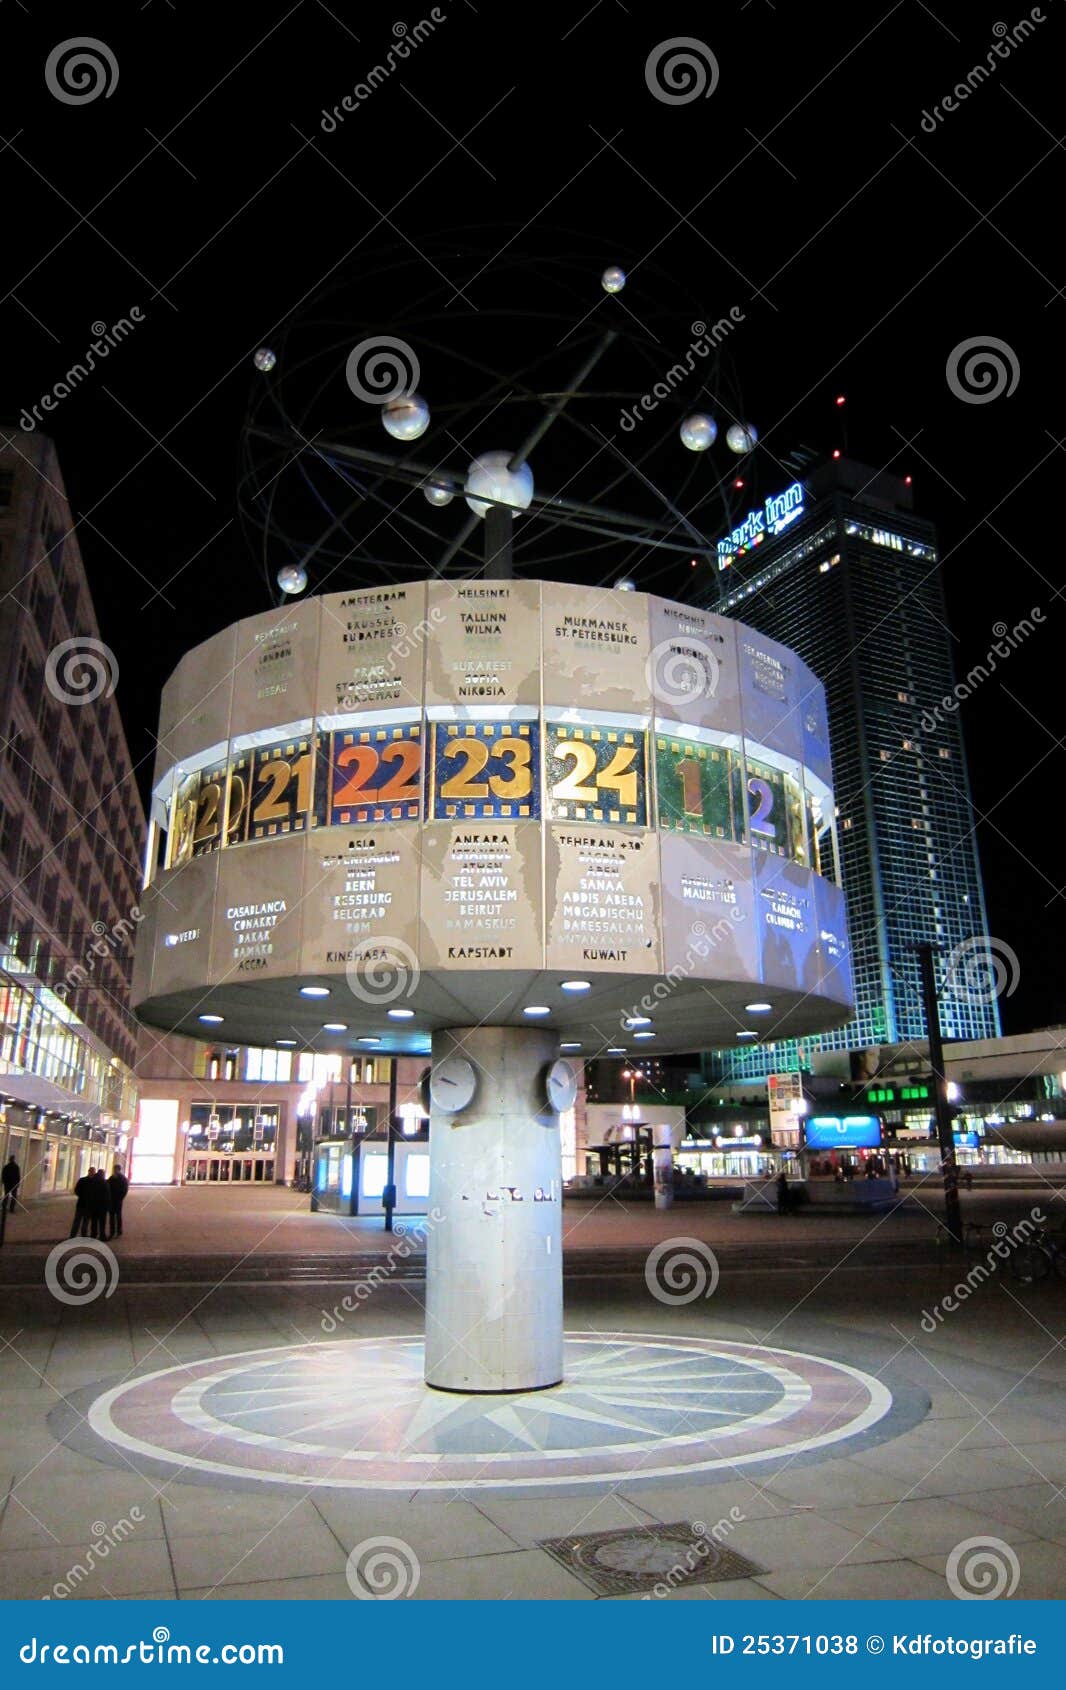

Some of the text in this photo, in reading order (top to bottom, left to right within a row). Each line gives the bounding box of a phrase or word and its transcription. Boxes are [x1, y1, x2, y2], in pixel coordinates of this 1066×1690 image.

[765, 483, 803, 526] inn
[341, 591, 406, 607] AMSTERDAM
[458, 589, 510, 598] HELSINKI
[460, 613, 507, 622] TALLINN
[465, 625, 502, 635] WILNA
[564, 616, 629, 634] MURMANSK
[464, 674, 500, 684] SOFIA
[458, 687, 506, 696] NIKOSIA
[334, 741, 421, 807] 22
[441, 738, 533, 799] 23
[552, 741, 638, 805] 24
[253, 754, 312, 822] 21
[675, 758, 704, 817] 1
[747, 777, 776, 838] 2
[454, 835, 510, 846] ANKARA
[560, 836, 615, 850] TEHERAN
[345, 880, 375, 892] BERN
[453, 876, 508, 888] TEL AVIV
[579, 879, 625, 893] SANAA
[445, 890, 517, 902] JERUSALEM
[562, 892, 644, 908] ADDIS ABEBA
[227, 900, 287, 919] CASABLANCA
[460, 904, 503, 916] BEIRUT
[563, 906, 643, 921] MOGADISCHU
[563, 920, 644, 935] DARESSALAM
[326, 949, 387, 962] KINSHASA
[448, 947, 513, 959] KAPSTADT
[583, 949, 627, 961] KUWAIT
